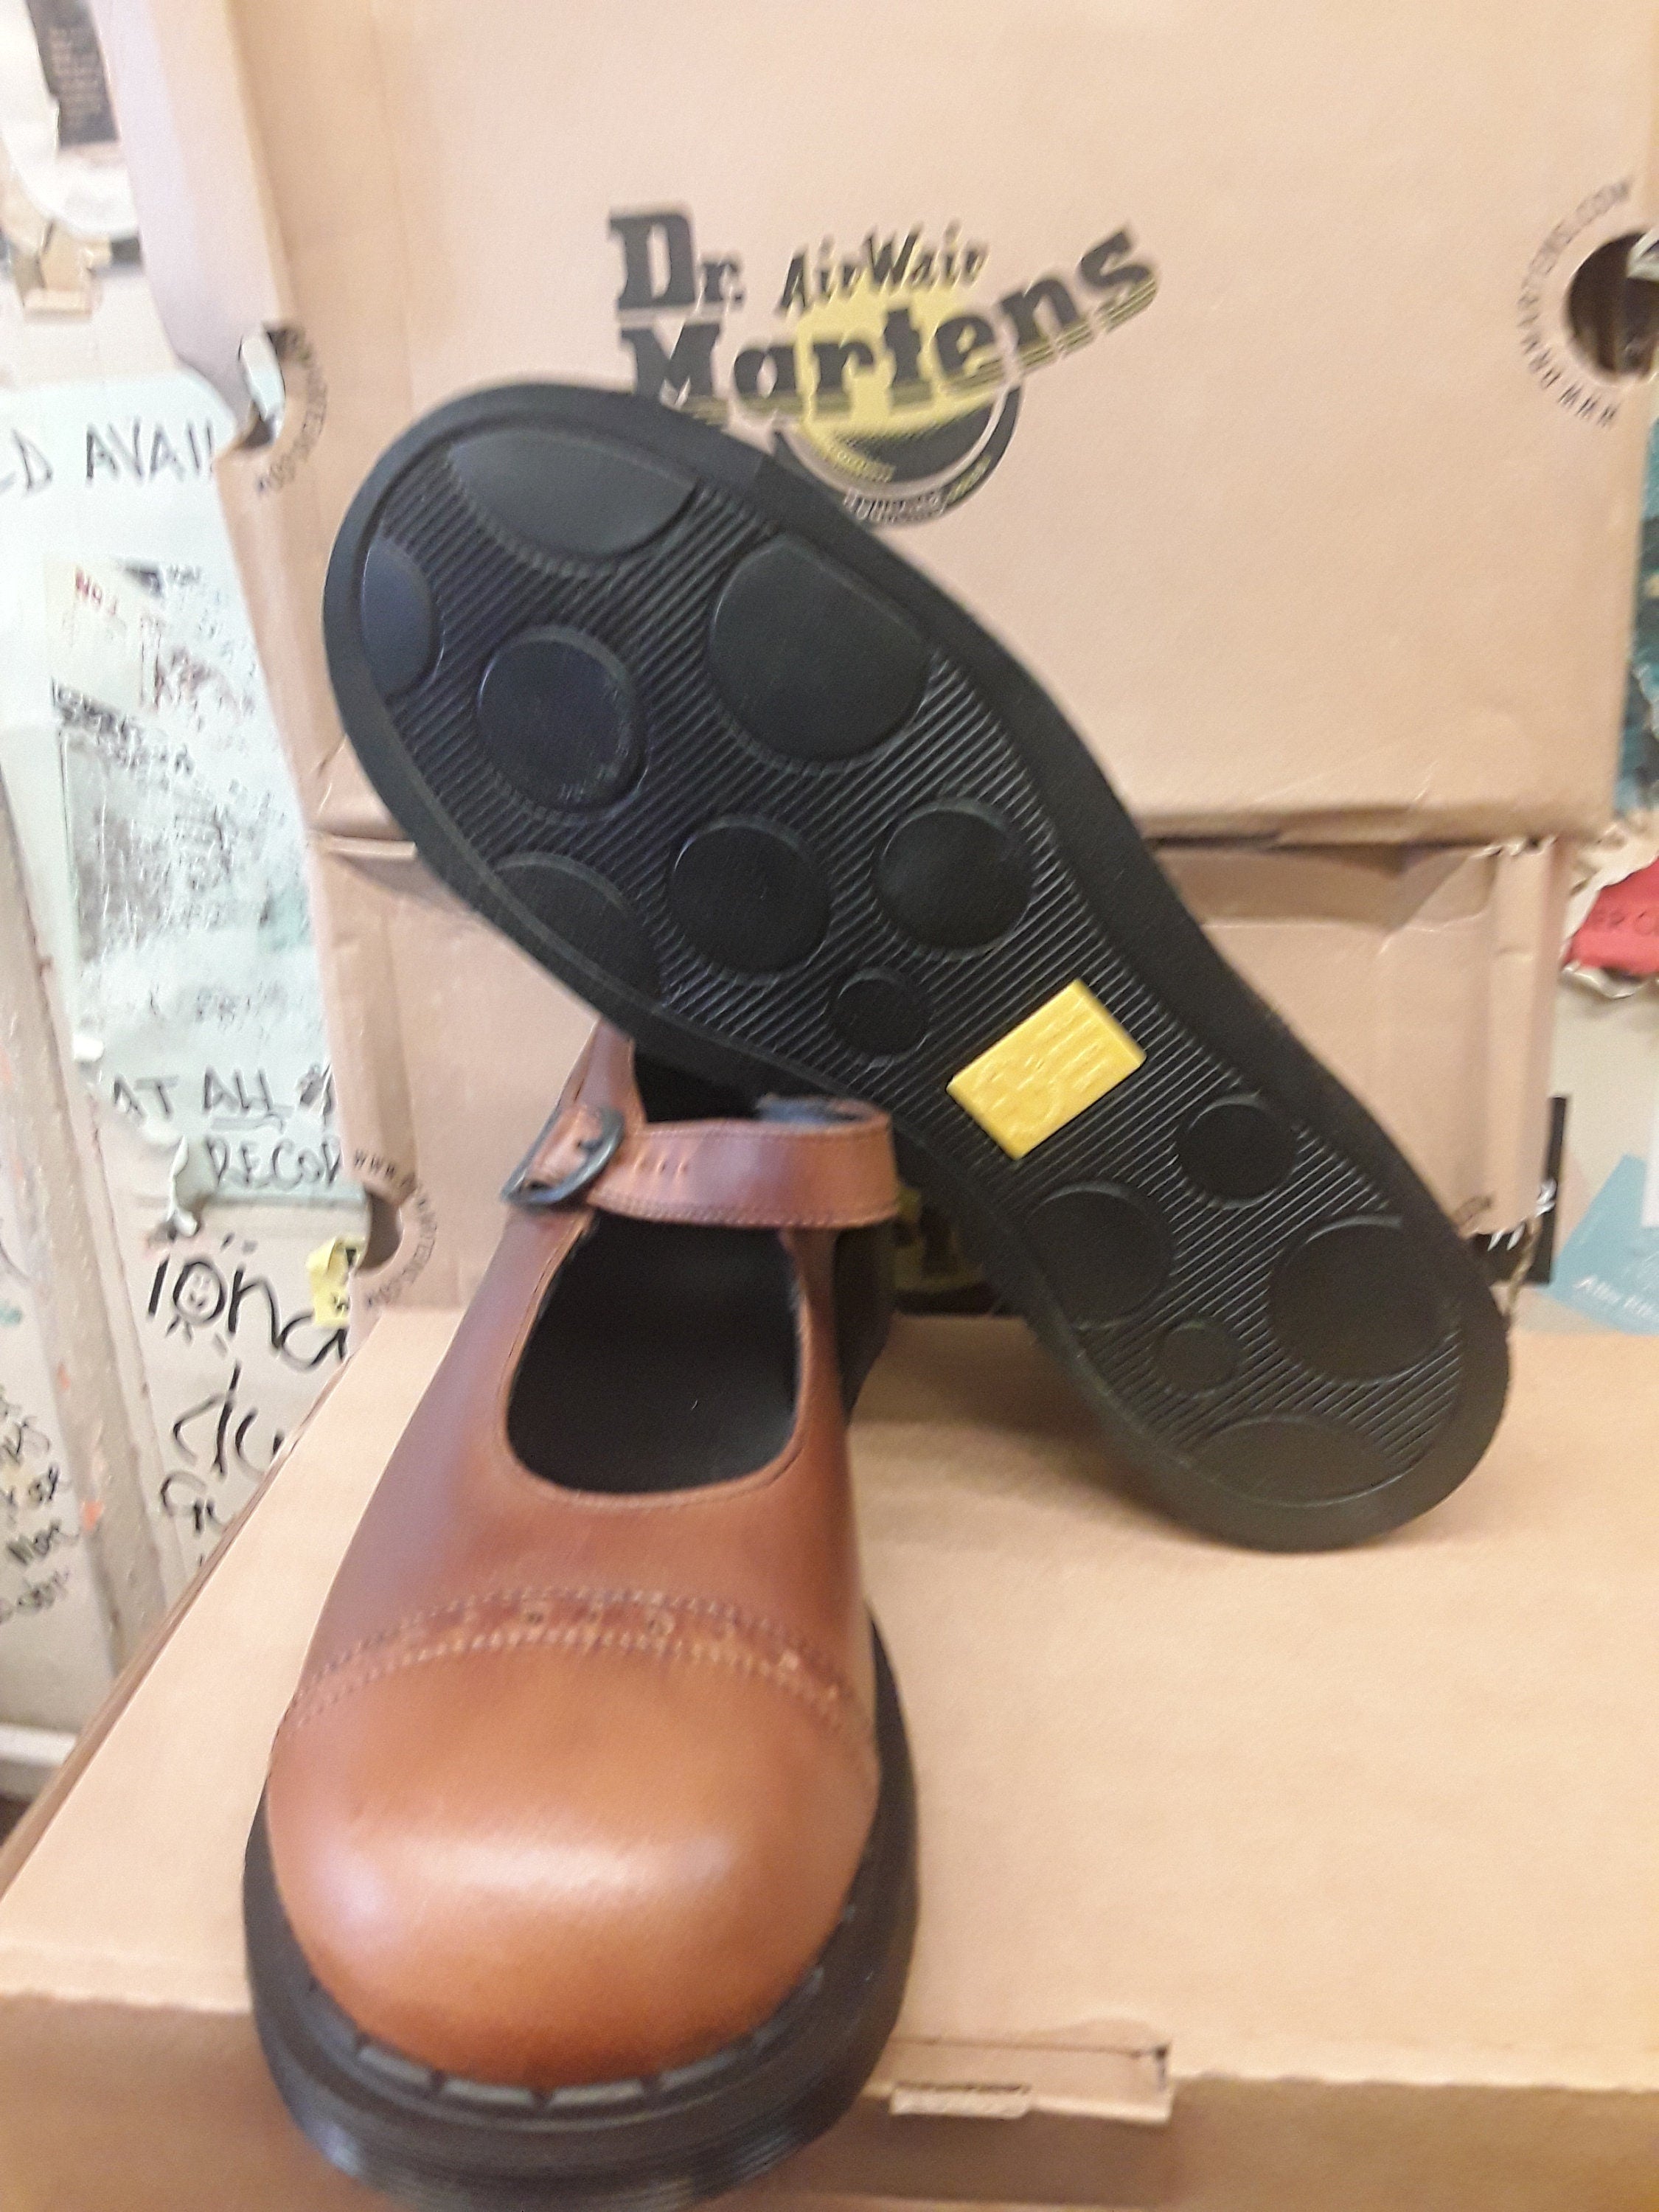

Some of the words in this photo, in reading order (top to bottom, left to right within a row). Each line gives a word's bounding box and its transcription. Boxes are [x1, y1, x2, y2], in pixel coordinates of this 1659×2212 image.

[609, 212, 746, 311] Dr.
[777, 220, 990, 316] AirWair
[618, 223, 1161, 407] Martens
